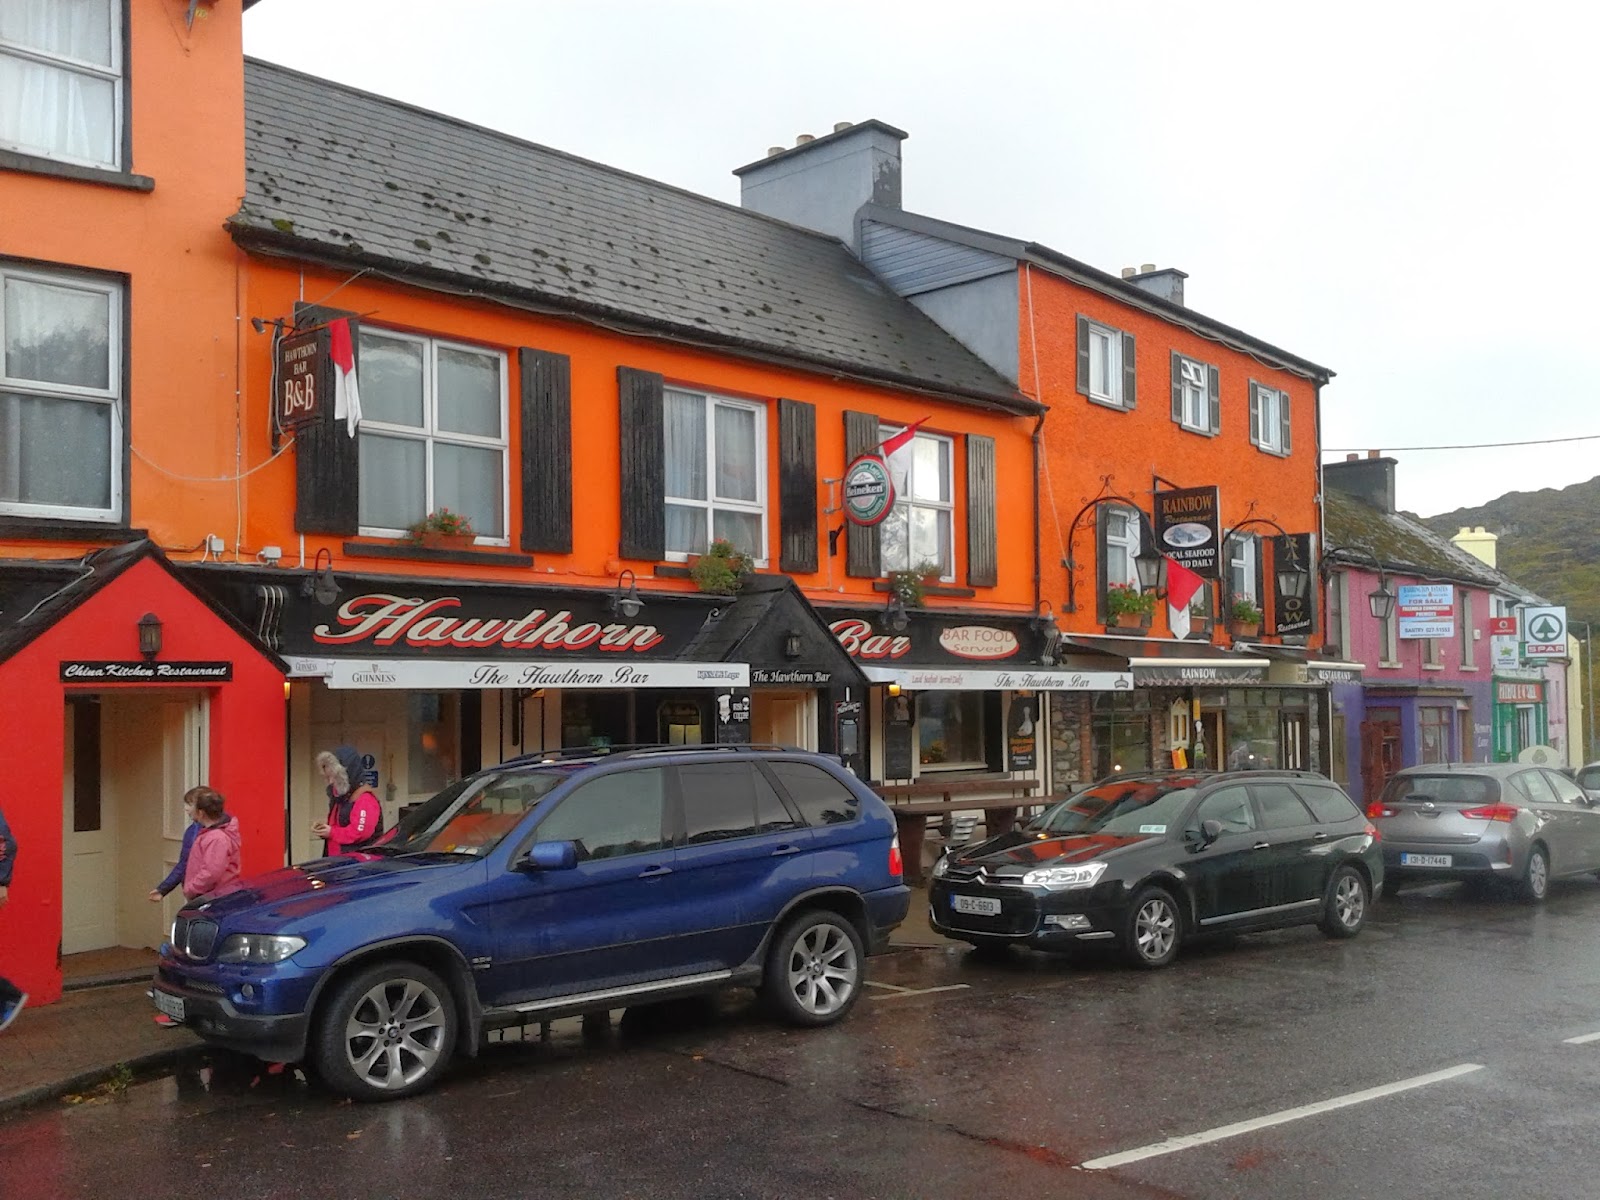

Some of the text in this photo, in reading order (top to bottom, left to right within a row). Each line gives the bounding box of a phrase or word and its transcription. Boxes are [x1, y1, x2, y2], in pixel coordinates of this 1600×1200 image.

[285, 342, 317, 362] HAWTHORN
[294, 361, 307, 375] BAR
[284, 373, 314, 416] B&B
[846, 483, 883, 498] Heineken
[1163, 495, 1213, 513] RAINBOW
[1184, 548, 1215, 558] SEAFOOD
[1191, 559, 1213, 568] DAILY
[313, 593, 664, 651] Hawthorn
[828, 619, 911, 658] Bar
[943, 628, 1014, 642] BAR FOOD
[953, 643, 1004, 653] Served
[1528, 645, 1564, 653] SPAR
[64, 664, 226, 677] China Kitchen Restaurant
[469, 663, 649, 685] The Hawthorn Bar
[753, 670, 831, 684] The Hawthorn Bar
[1181, 668, 1216, 679] RAINBOW
[1319, 670, 1351, 681] RESTAURANT
[352, 673, 396, 683] GUINNESS
[994, 672, 1090, 687] The Hawthorn Bar
